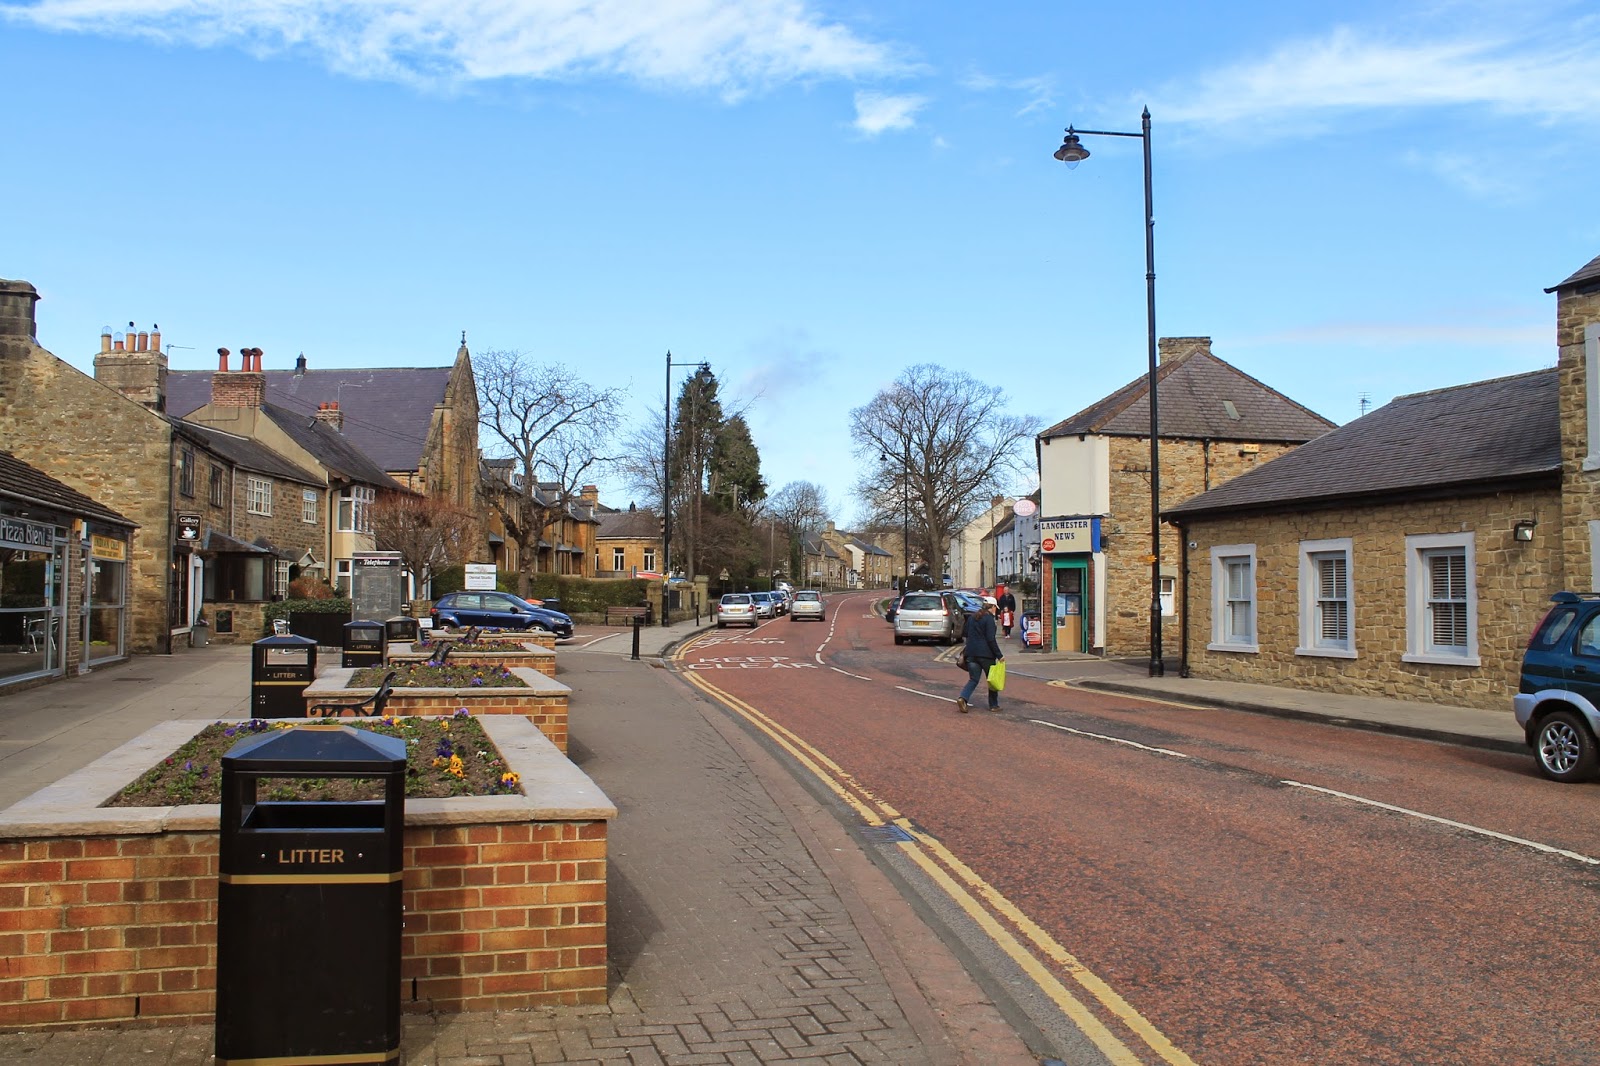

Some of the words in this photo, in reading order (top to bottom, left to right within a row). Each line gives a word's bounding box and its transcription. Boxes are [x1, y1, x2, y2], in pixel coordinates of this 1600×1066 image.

[1041, 521, 1088, 530] LANCHESTER
[0, 519, 25, 542] Pizza
[1054, 533, 1075, 541] NEWS
[364, 559, 391, 567] Telephone
[279, 849, 345, 864] LITTER
